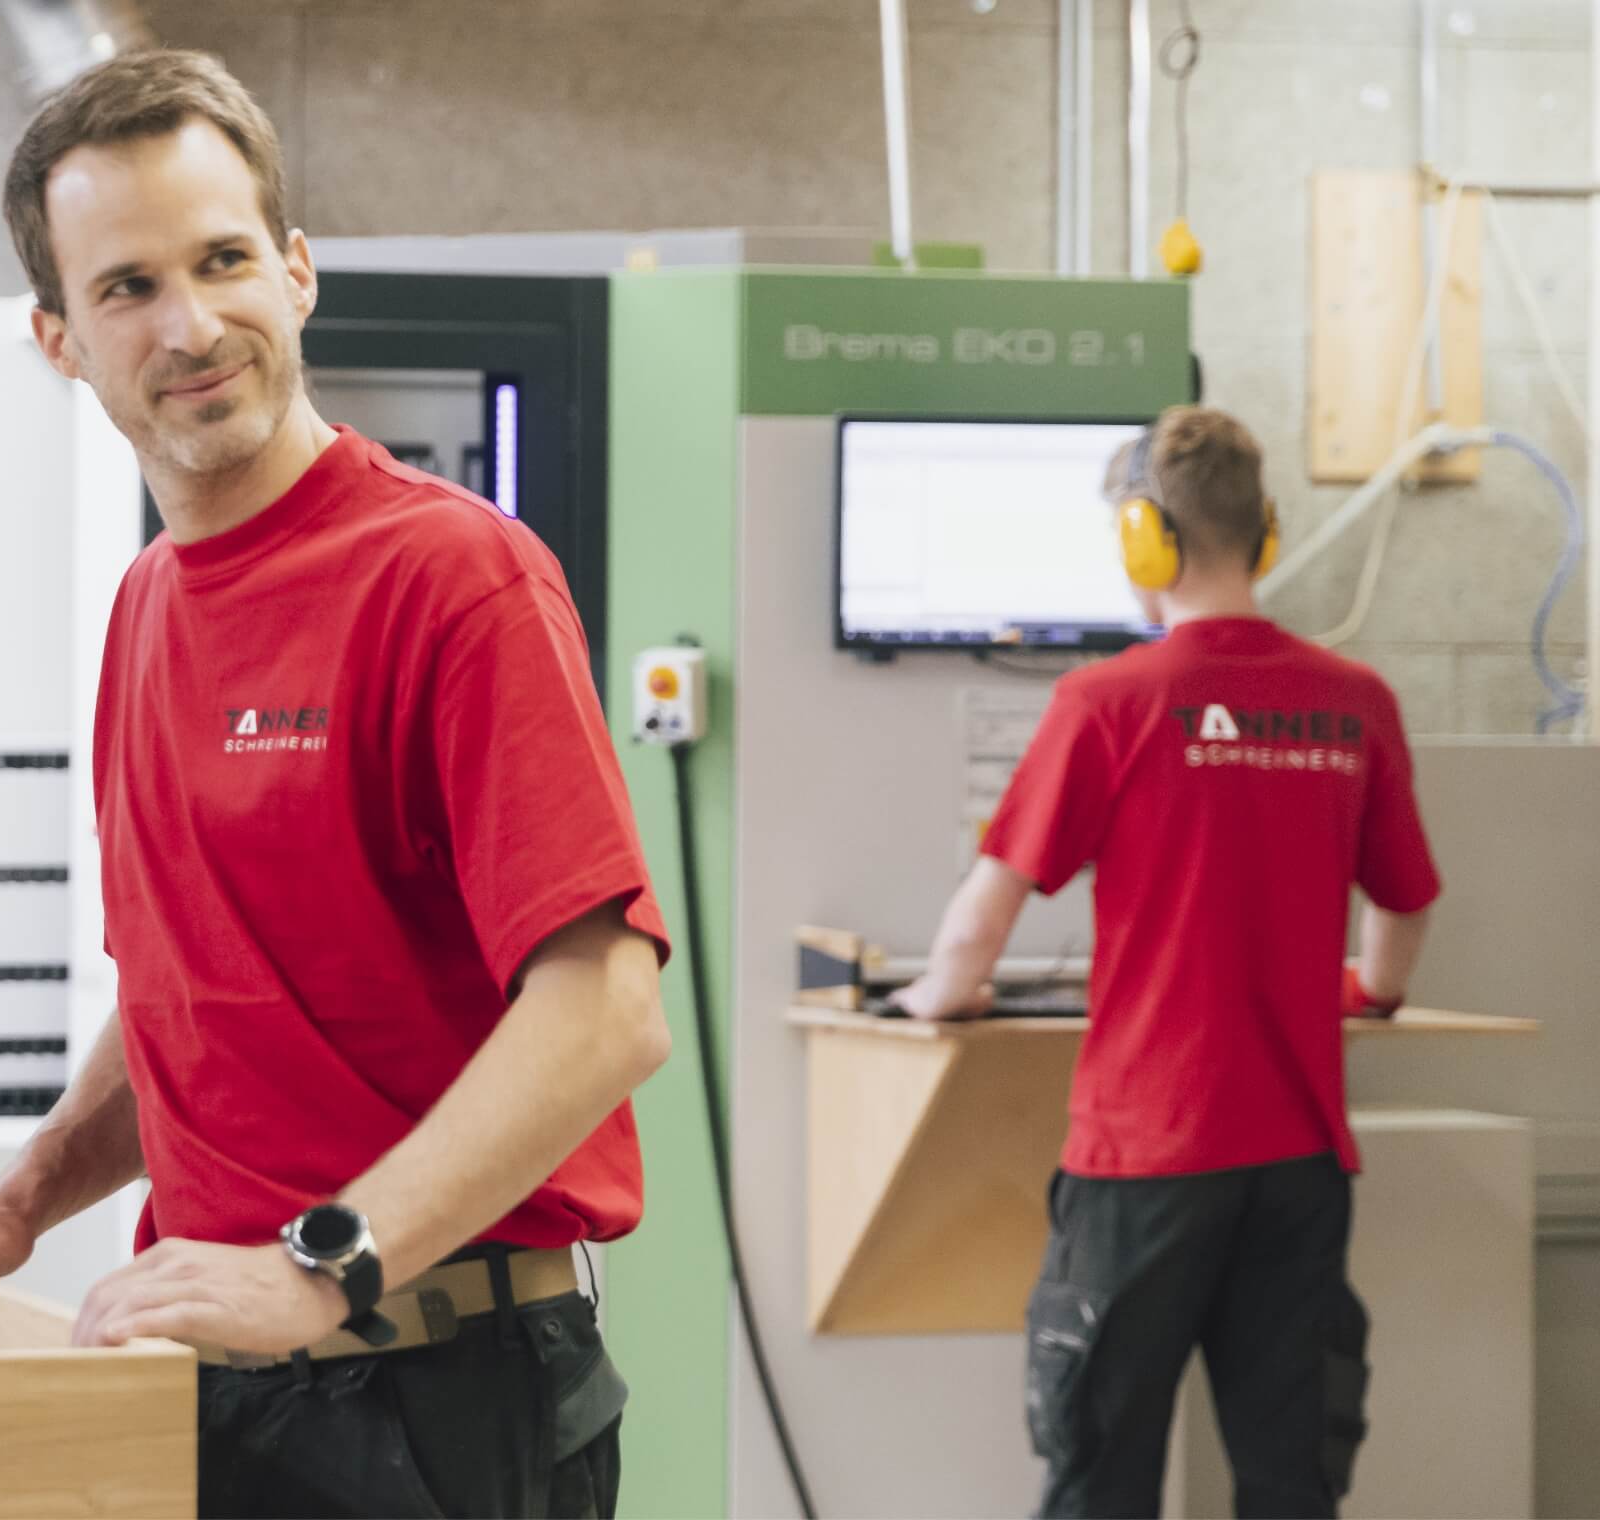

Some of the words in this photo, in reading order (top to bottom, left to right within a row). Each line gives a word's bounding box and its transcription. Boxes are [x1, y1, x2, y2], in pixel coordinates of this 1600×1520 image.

[952, 327, 1056, 365] EKO
[1068, 329, 1145, 367] 2.1
[223, 706, 329, 736] TANNER
[1170, 703, 1362, 743] TANNER
[223, 735, 328, 753] SCHREINEREI
